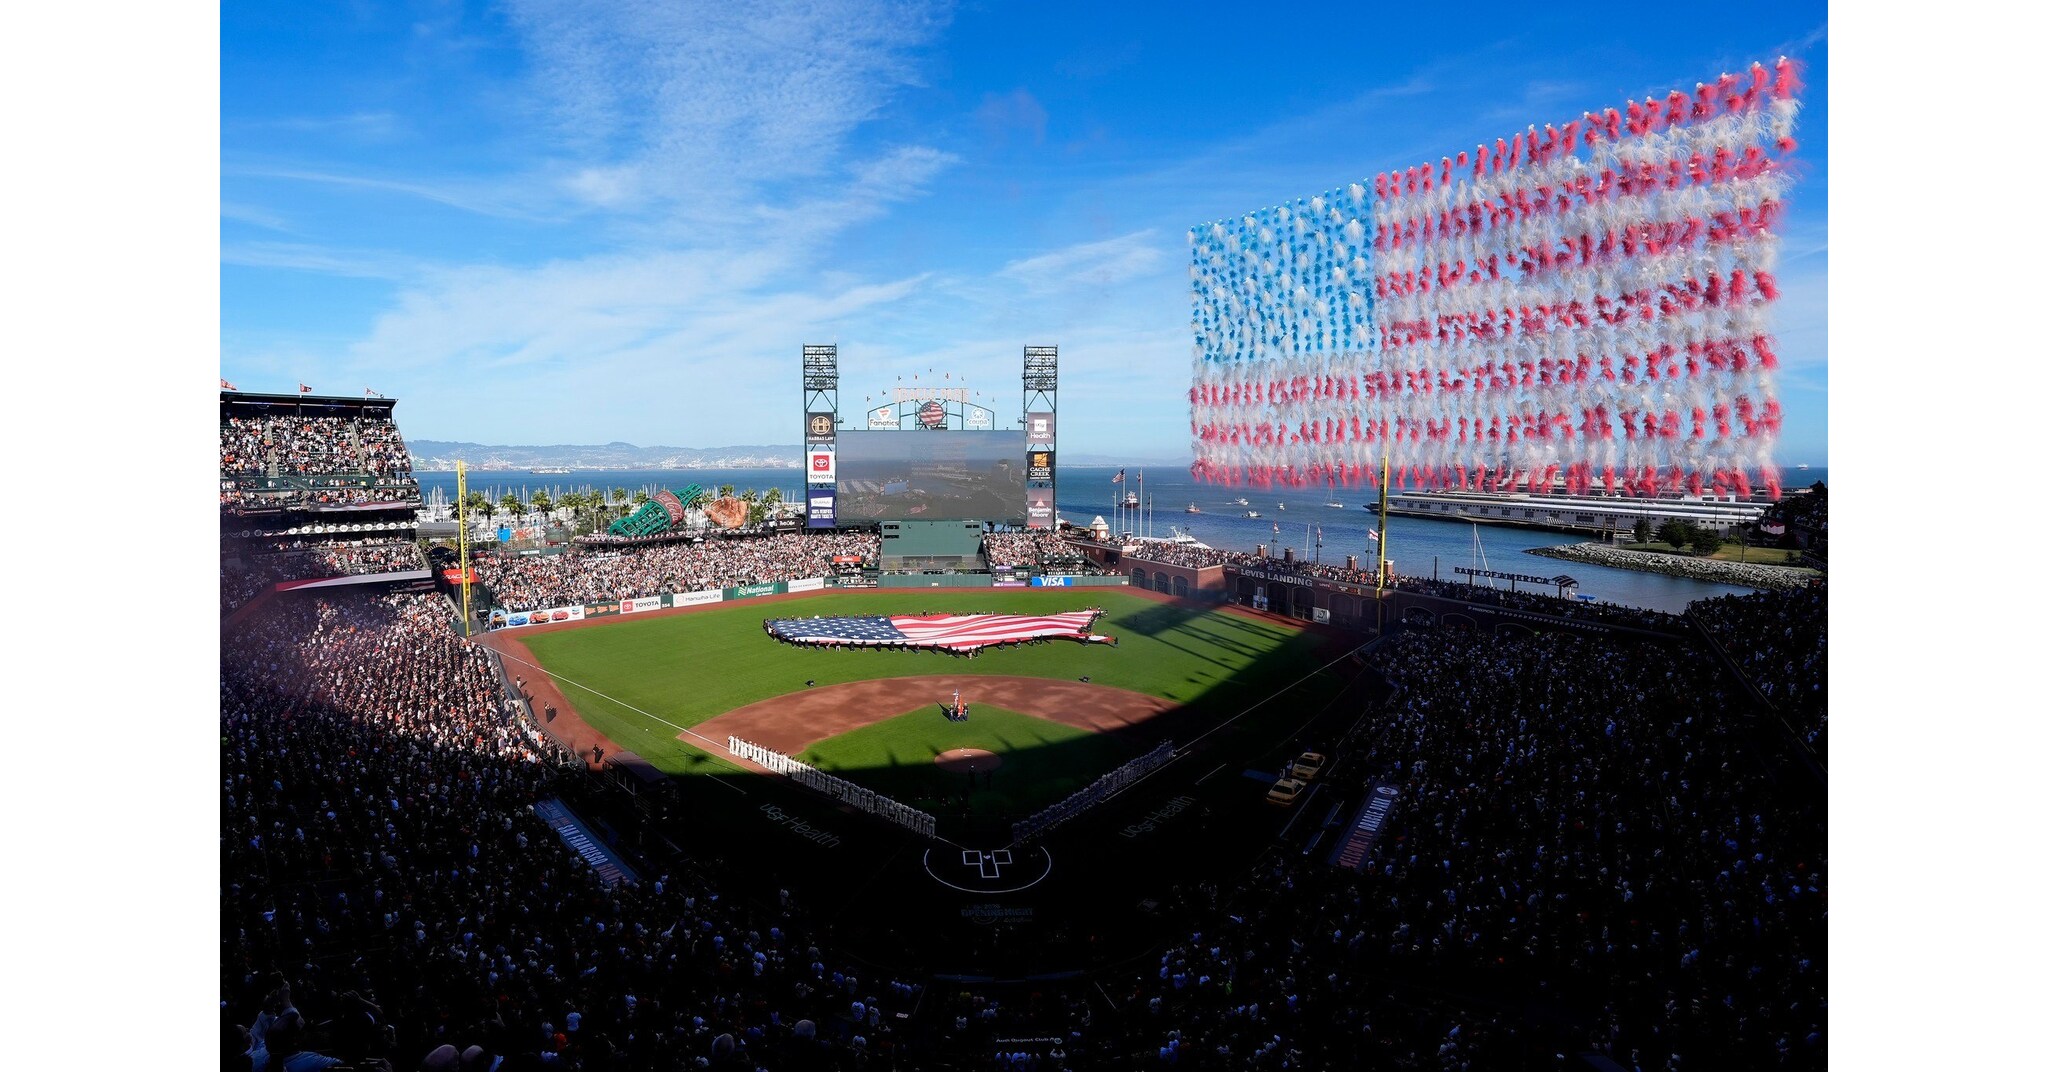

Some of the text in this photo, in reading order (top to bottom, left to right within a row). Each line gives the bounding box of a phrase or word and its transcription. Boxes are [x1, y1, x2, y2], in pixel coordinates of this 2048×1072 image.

[870, 419, 900, 427] Fanatics
[1040, 576, 1064, 586] VISA
[1267, 572, 1313, 587] LANDING
[1454, 566, 1482, 576] BANK
[1498, 572, 1550, 584] AMERICA
[746, 585, 774, 594] National
[1144, 795, 1197, 824] Health
[558, 824, 580, 837] SAN
[782, 817, 840, 848] Health
[567, 834, 608, 866] FRANCISCO
